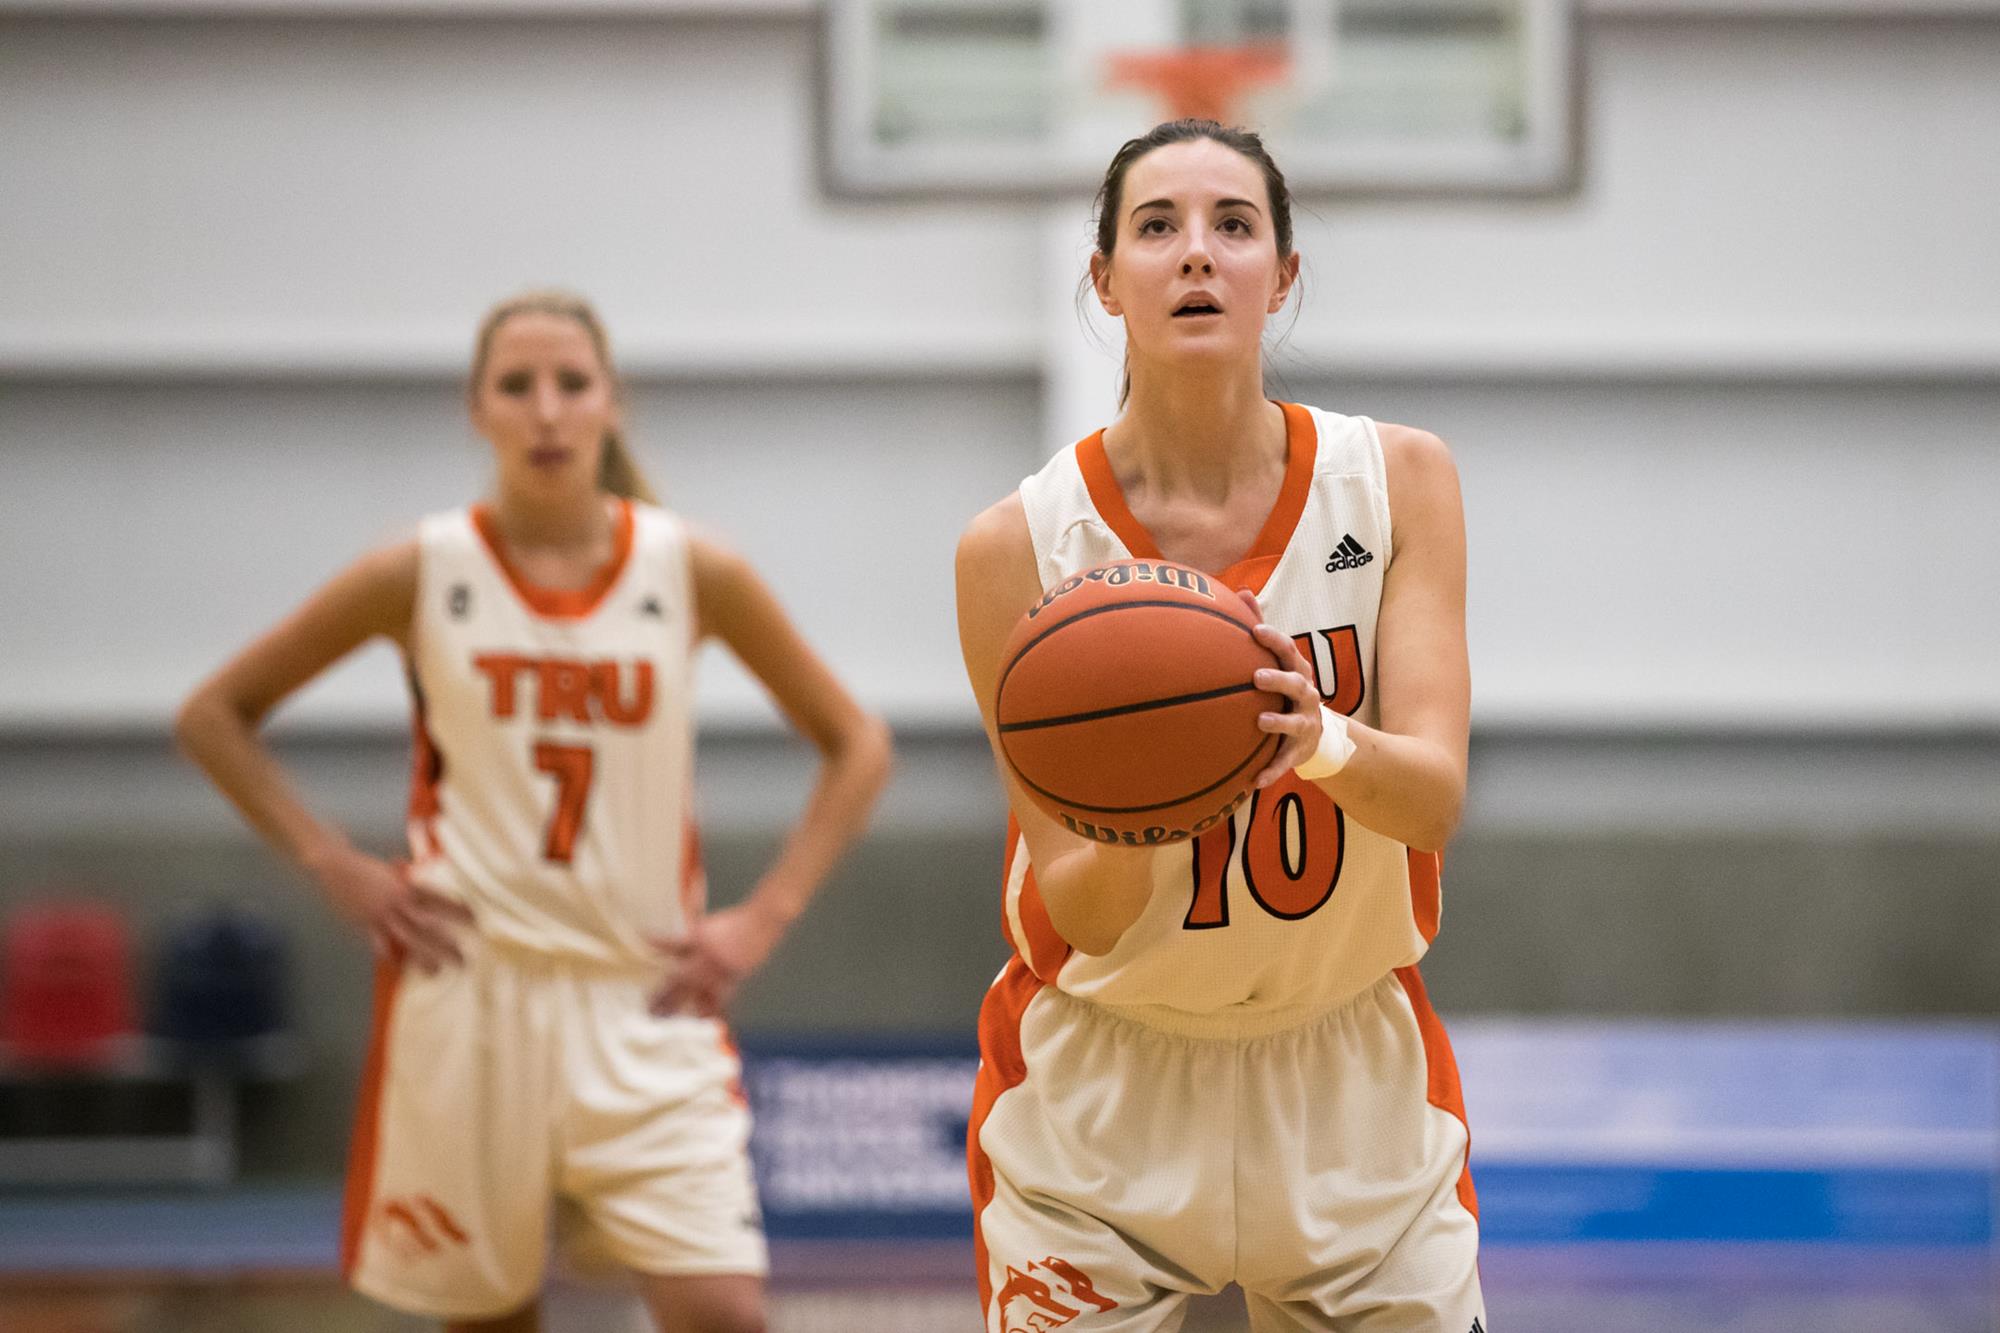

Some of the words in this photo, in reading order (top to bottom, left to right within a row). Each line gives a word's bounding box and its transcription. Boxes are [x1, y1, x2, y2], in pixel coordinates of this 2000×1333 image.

[1029, 562, 1216, 620] Wilson
[1325, 551, 1374, 573] adidas
[473, 652, 657, 729] TRU
[532, 741, 596, 865] 7
[1059, 789, 1249, 846] Wilson
[1182, 768, 1345, 931] 10
